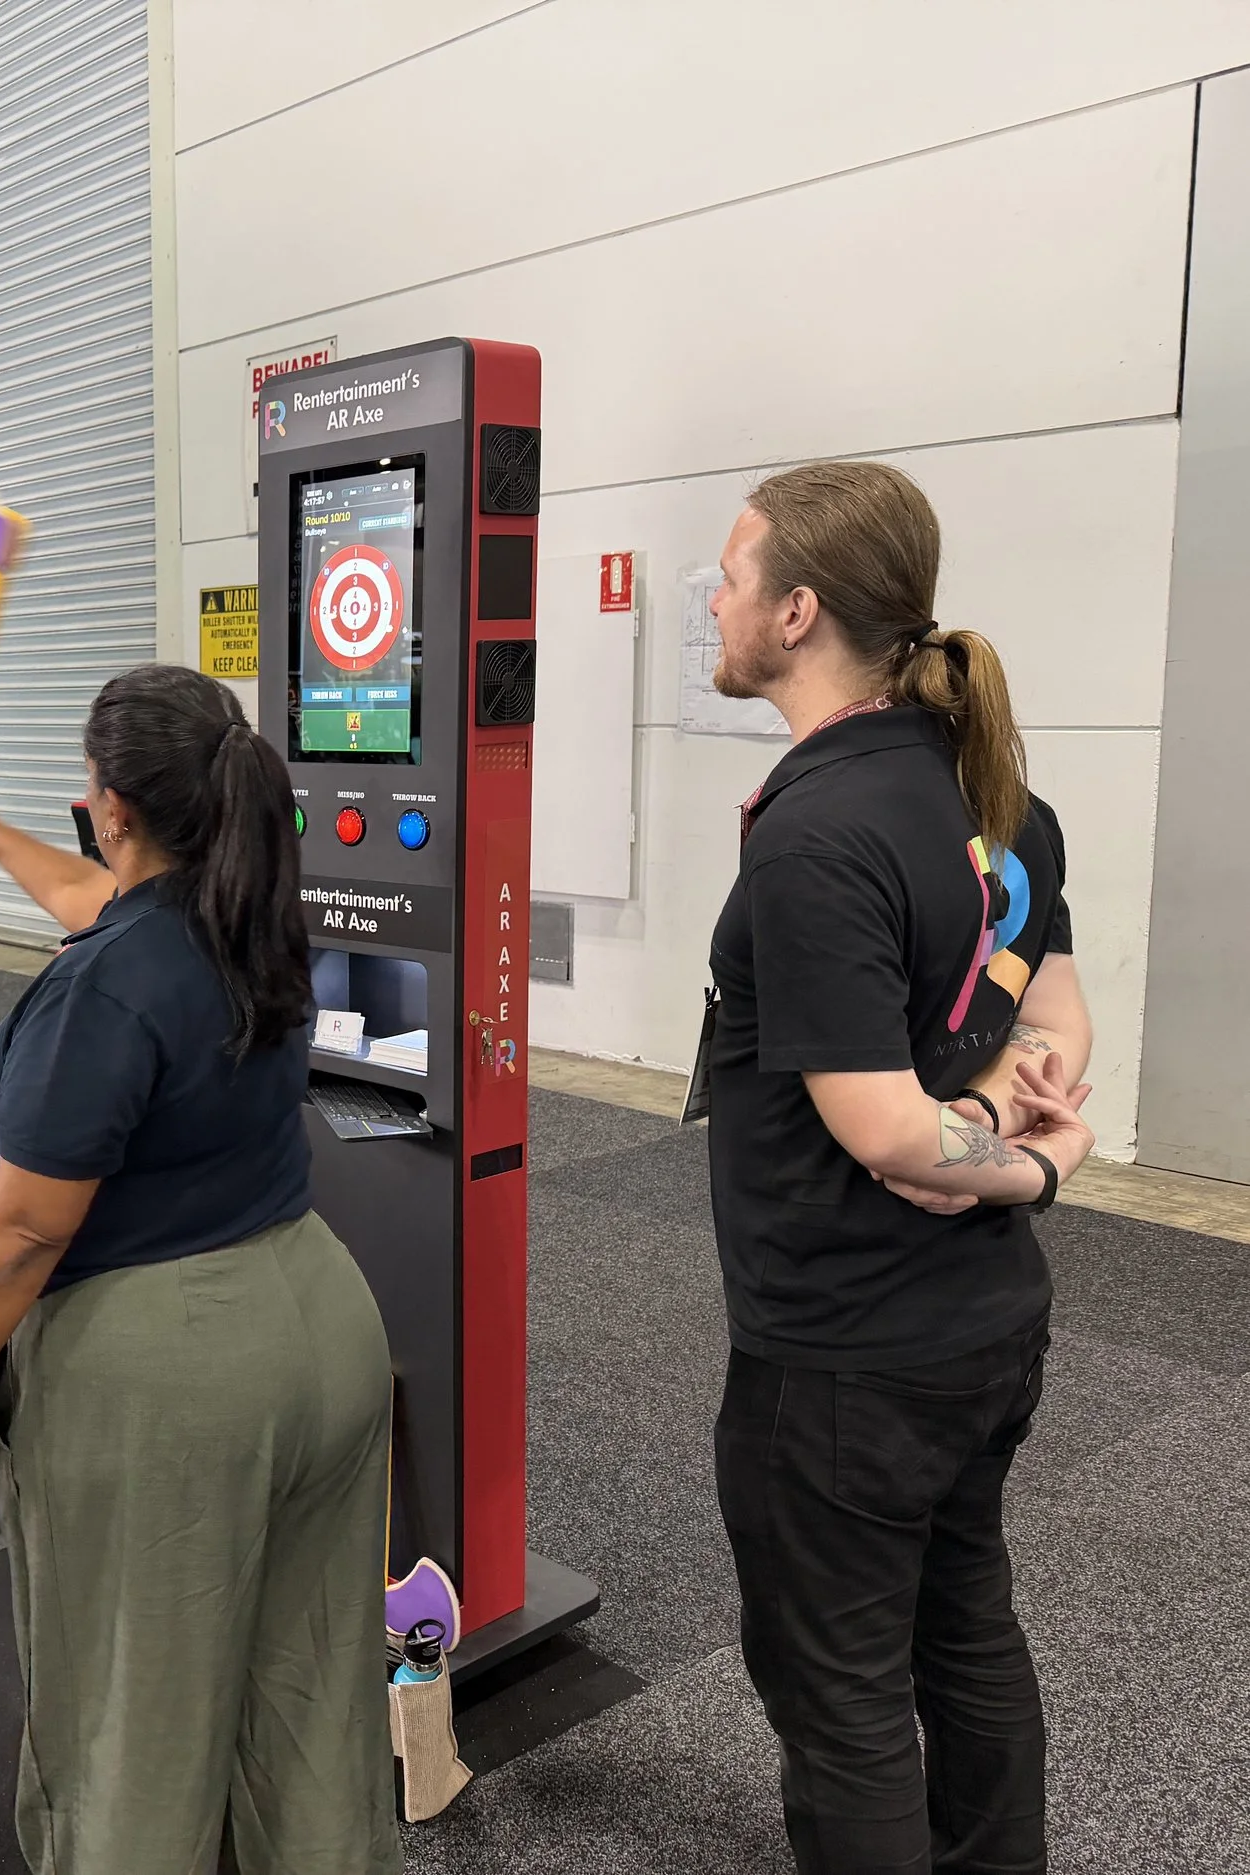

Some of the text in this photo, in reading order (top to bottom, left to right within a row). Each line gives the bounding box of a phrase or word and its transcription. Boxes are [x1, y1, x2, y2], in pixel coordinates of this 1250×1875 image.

[293, 368, 420, 412] Rentertainment's
[326, 405, 384, 431] AR Axe
[305, 511, 351, 527] Round 10/10
[224, 588, 258, 612] WARNI
[213, 656, 258, 672] KEEP CLEA
[392, 793, 417, 802] THROW
[300, 888, 413, 914] entertainment's
[323, 909, 379, 934] AR Axe
